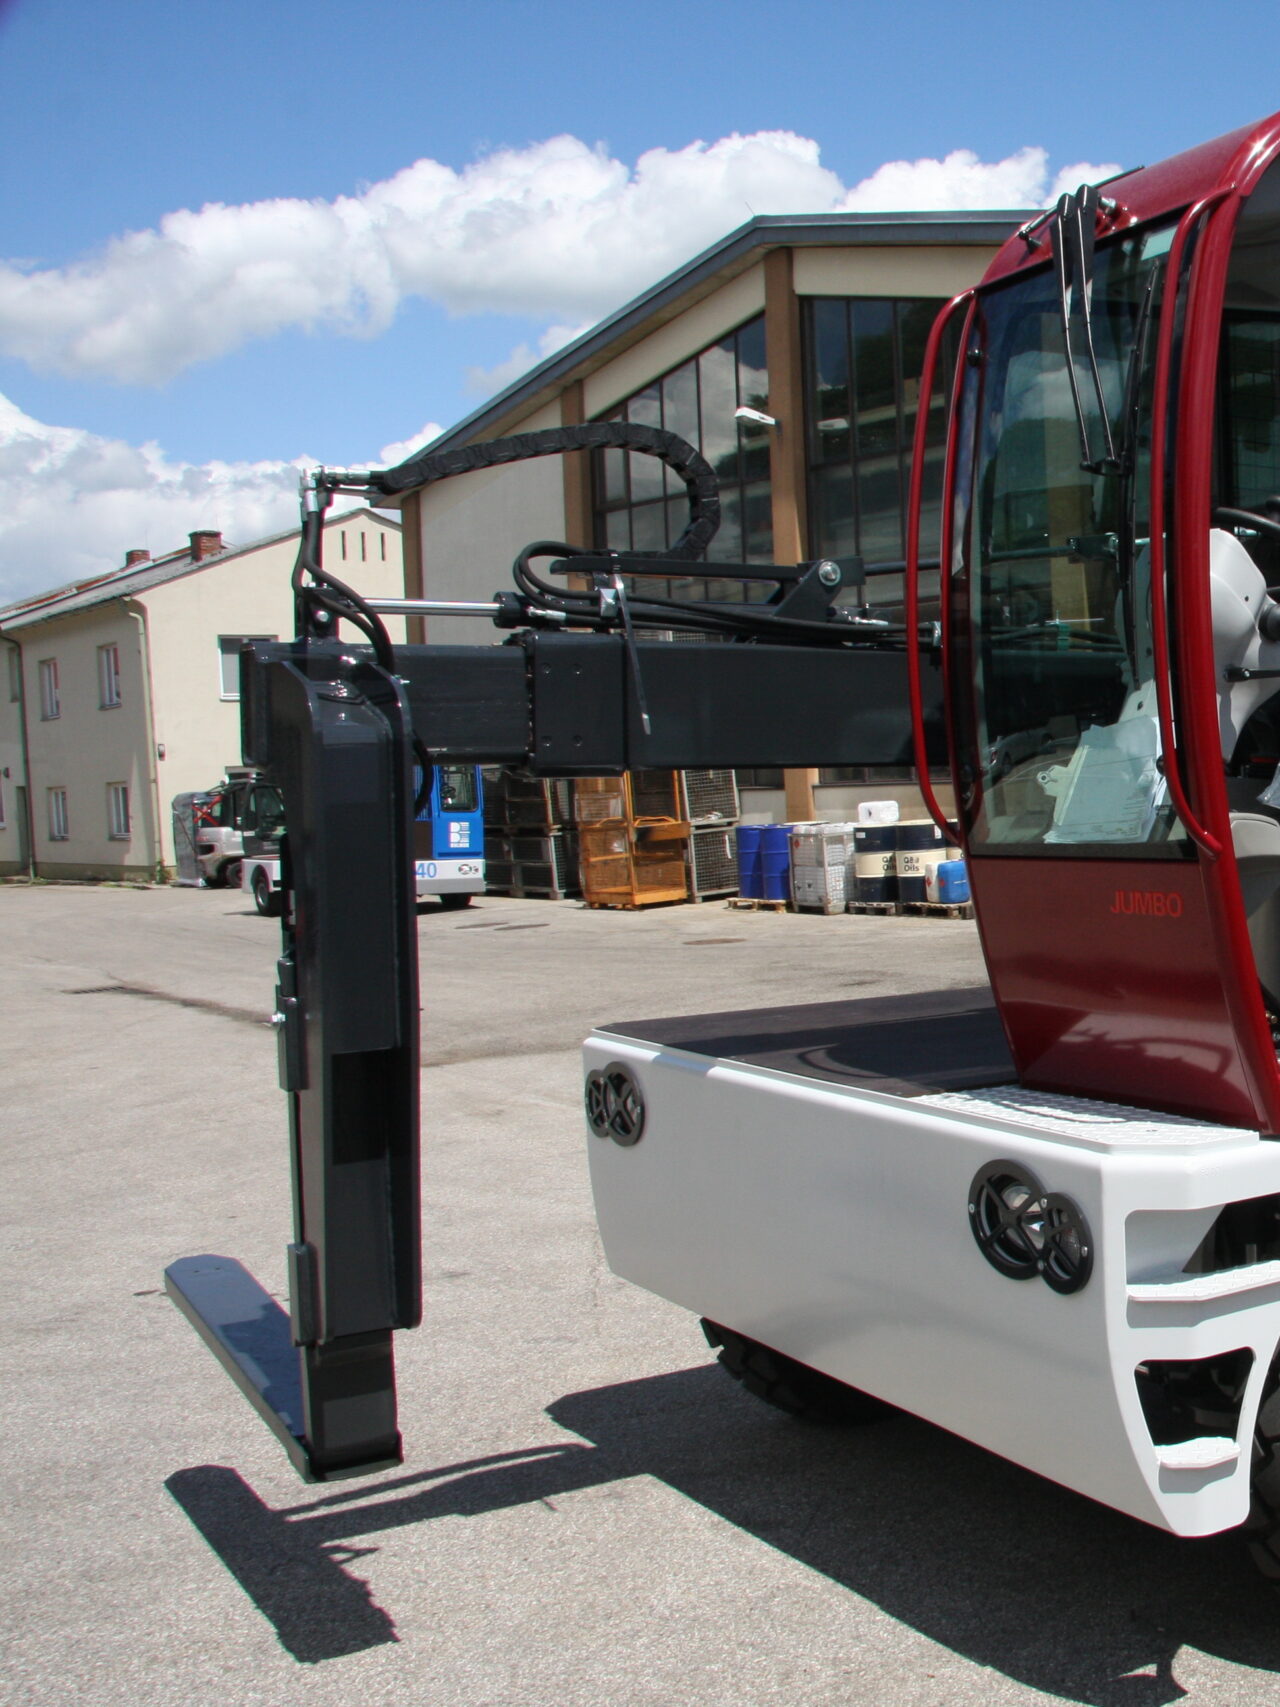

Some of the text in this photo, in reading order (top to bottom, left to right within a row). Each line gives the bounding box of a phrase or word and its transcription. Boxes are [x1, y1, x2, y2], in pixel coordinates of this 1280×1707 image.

[415, 862, 438, 878] 40
[903, 864, 920, 872] Oils
[1110, 889, 1184, 918] JUMBO
